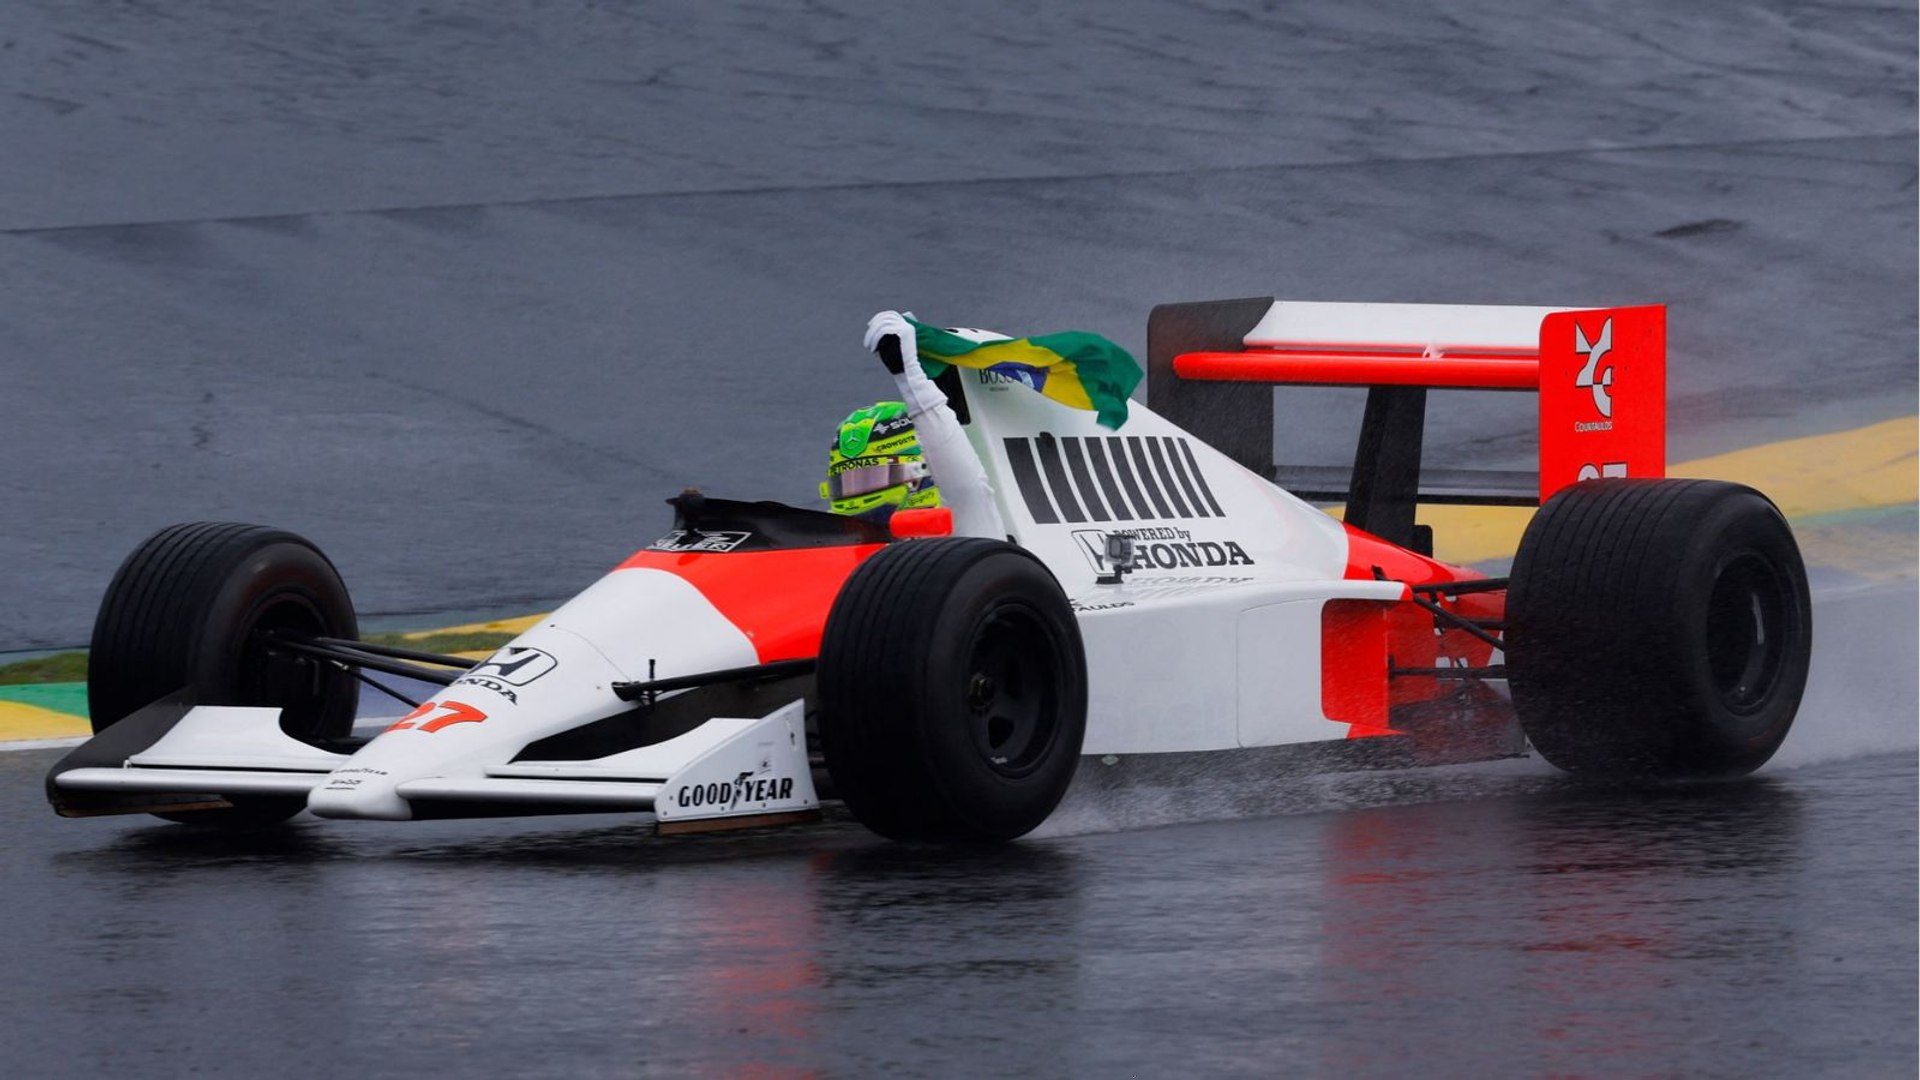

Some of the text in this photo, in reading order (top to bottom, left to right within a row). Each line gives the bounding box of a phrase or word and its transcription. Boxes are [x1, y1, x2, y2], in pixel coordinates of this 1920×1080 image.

[1174, 527, 1192, 542] by
[1132, 541, 1255, 569] HONDA
[384, 700, 489, 734] 27
